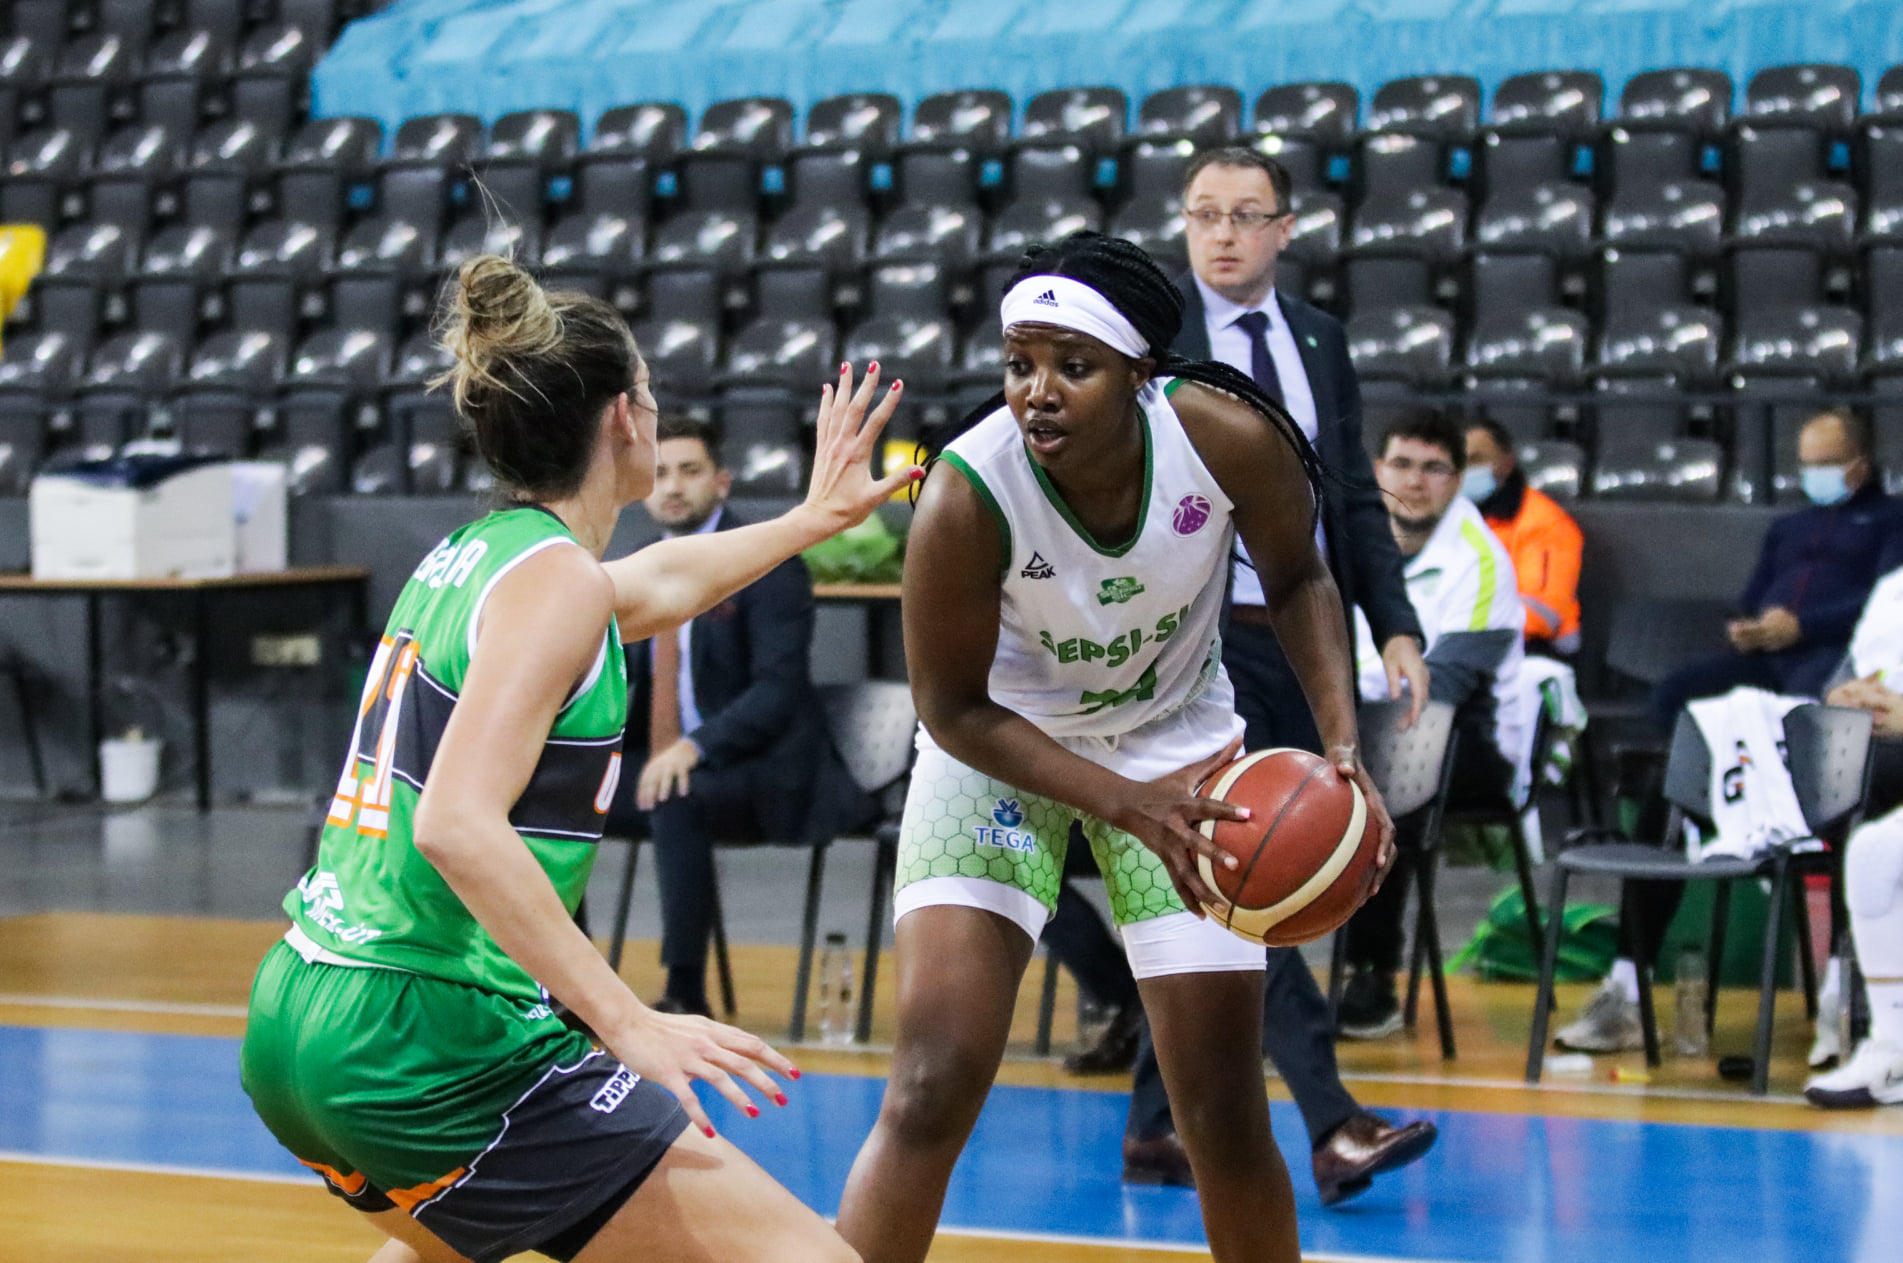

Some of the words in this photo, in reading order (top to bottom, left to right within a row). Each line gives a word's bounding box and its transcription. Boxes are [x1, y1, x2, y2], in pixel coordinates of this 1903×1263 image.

[1033, 297, 1059, 308] adidas
[1021, 565, 1056, 580] PEAK
[1039, 600, 1191, 668] EPSI-SI
[974, 826, 1035, 853] TEGA
